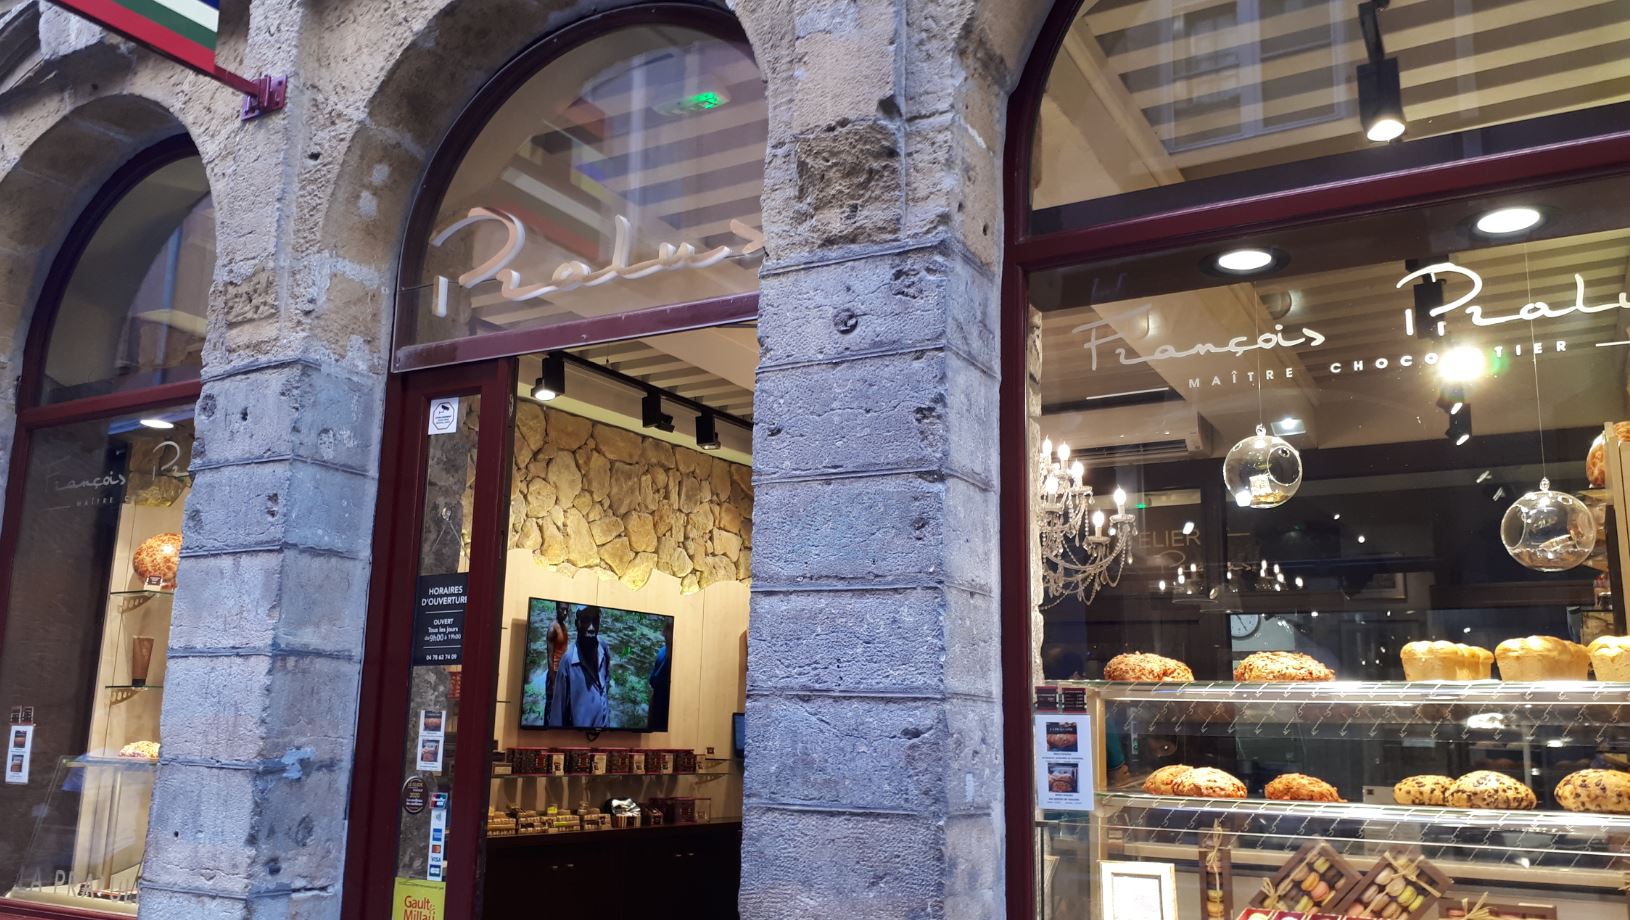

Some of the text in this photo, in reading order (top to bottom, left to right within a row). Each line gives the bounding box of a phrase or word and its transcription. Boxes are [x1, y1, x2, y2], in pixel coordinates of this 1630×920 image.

[1072, 303, 1326, 372] François
[1188, 340, 1567, 389] MAÎTRE CHOCOTIER
[1138, 529, 1201, 549] ELIER
[429, 586, 463, 595] HORAIRES
[404, 895, 431, 911] Gault
